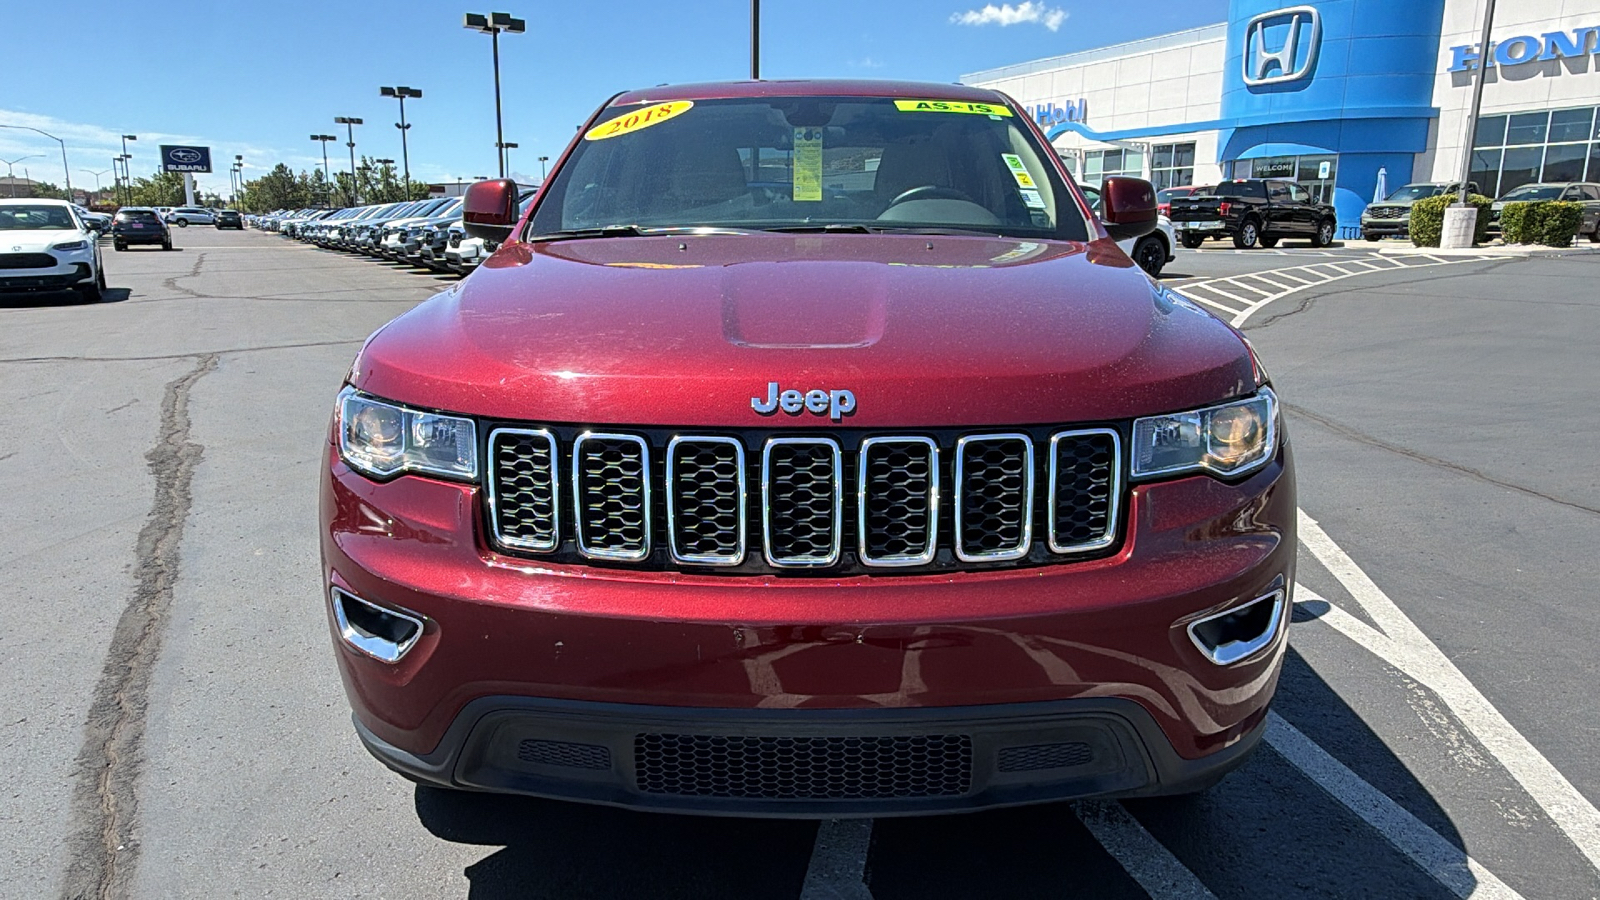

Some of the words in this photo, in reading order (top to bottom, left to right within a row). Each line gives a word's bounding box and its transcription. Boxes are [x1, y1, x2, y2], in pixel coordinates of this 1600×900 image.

[1447, 25, 1600, 72] HON
[606, 104, 673, 136] 2018
[1036, 98, 1086, 124] Hohl
[1256, 164, 1293, 172] WELCOME
[751, 382, 856, 420] Jeep
